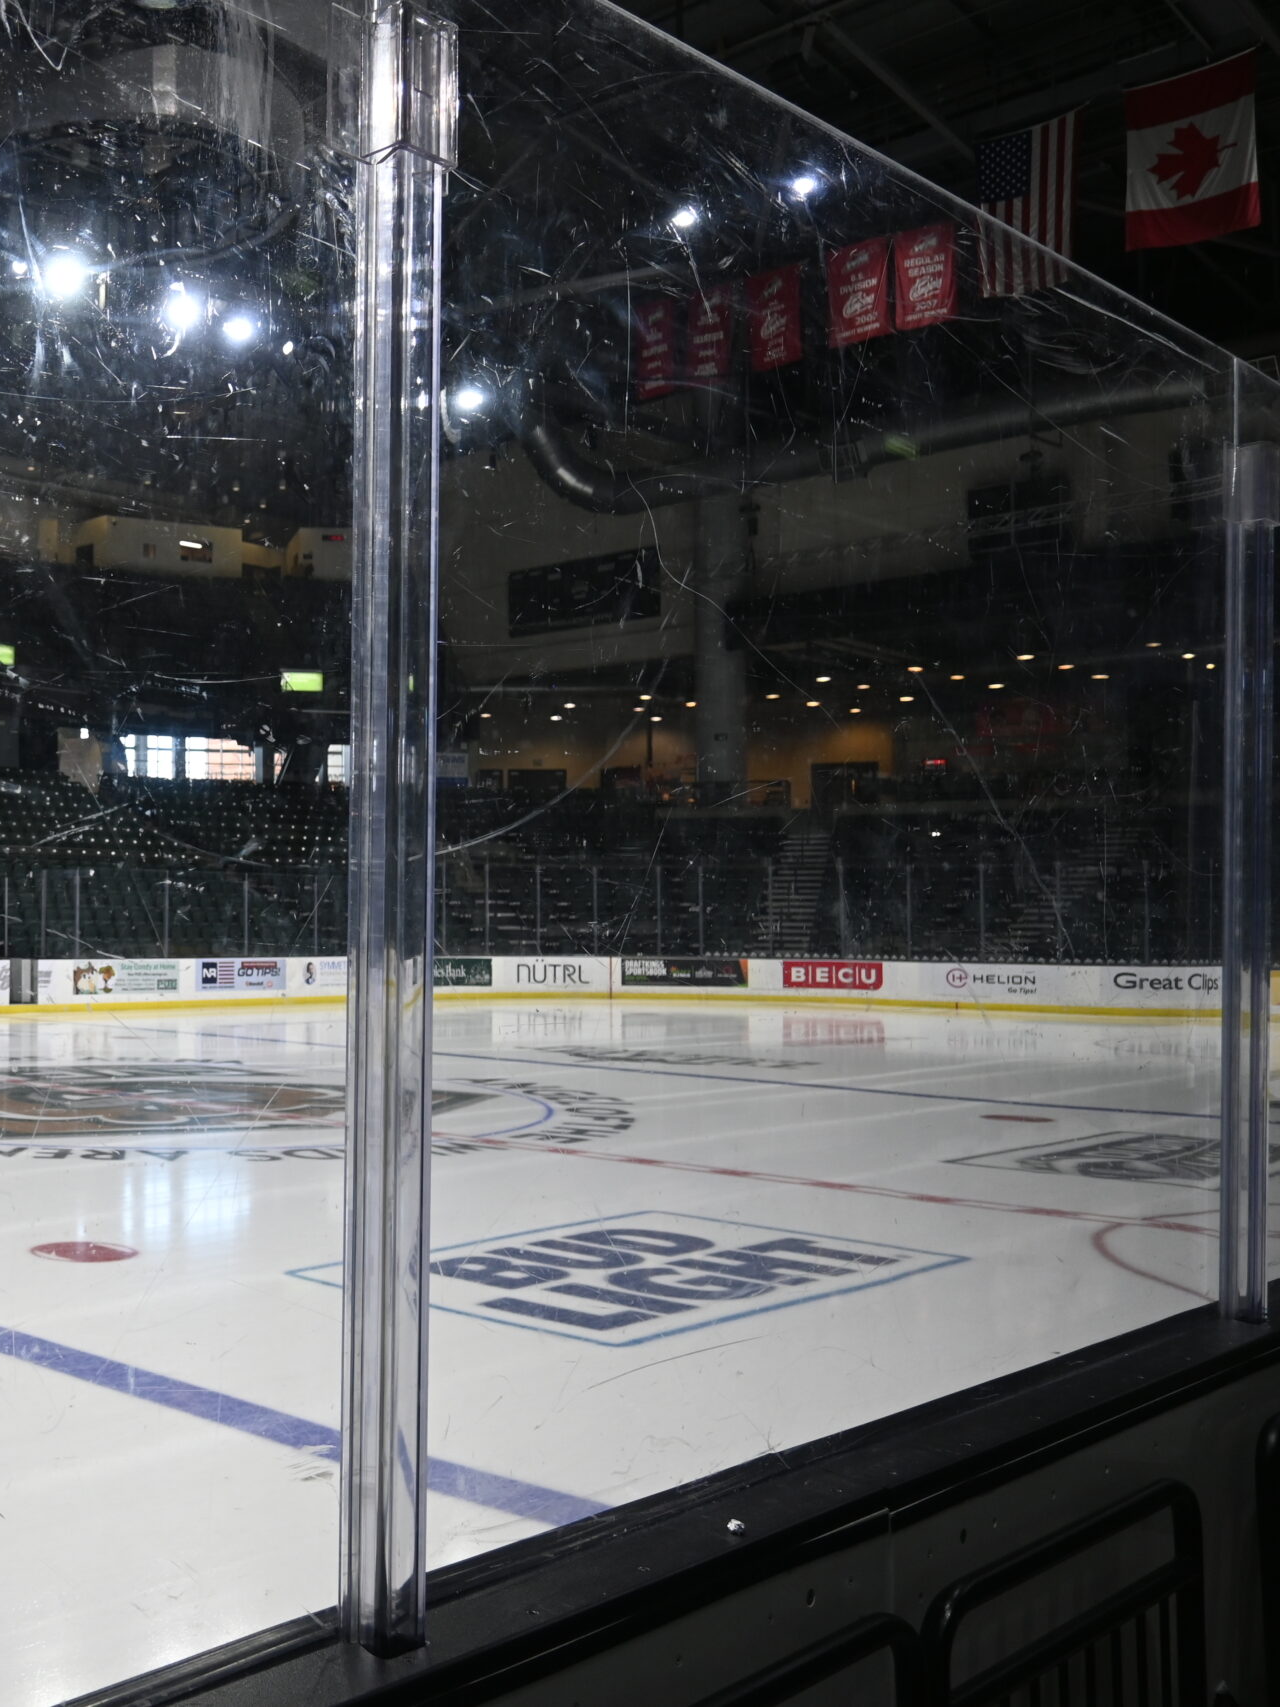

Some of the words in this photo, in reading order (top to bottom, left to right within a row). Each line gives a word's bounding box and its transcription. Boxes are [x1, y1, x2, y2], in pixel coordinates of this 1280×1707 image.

[904, 253, 945, 268] REGULAR
[908, 264, 944, 277] SEASON
[839, 277, 878, 295] DIVISION
[625, 960, 665, 968] DRAFTKINGS
[237, 969, 254, 978] GO
[256, 968, 281, 977] TIPS!
[625, 968, 667, 977] SPORTSBOOK
[973, 973, 1036, 986] HELION
[1113, 972, 1184, 991] Great
[1188, 973, 1219, 995] Clips
[429, 1227, 718, 1290] BUD
[477, 1236, 905, 1332] LIGHT
